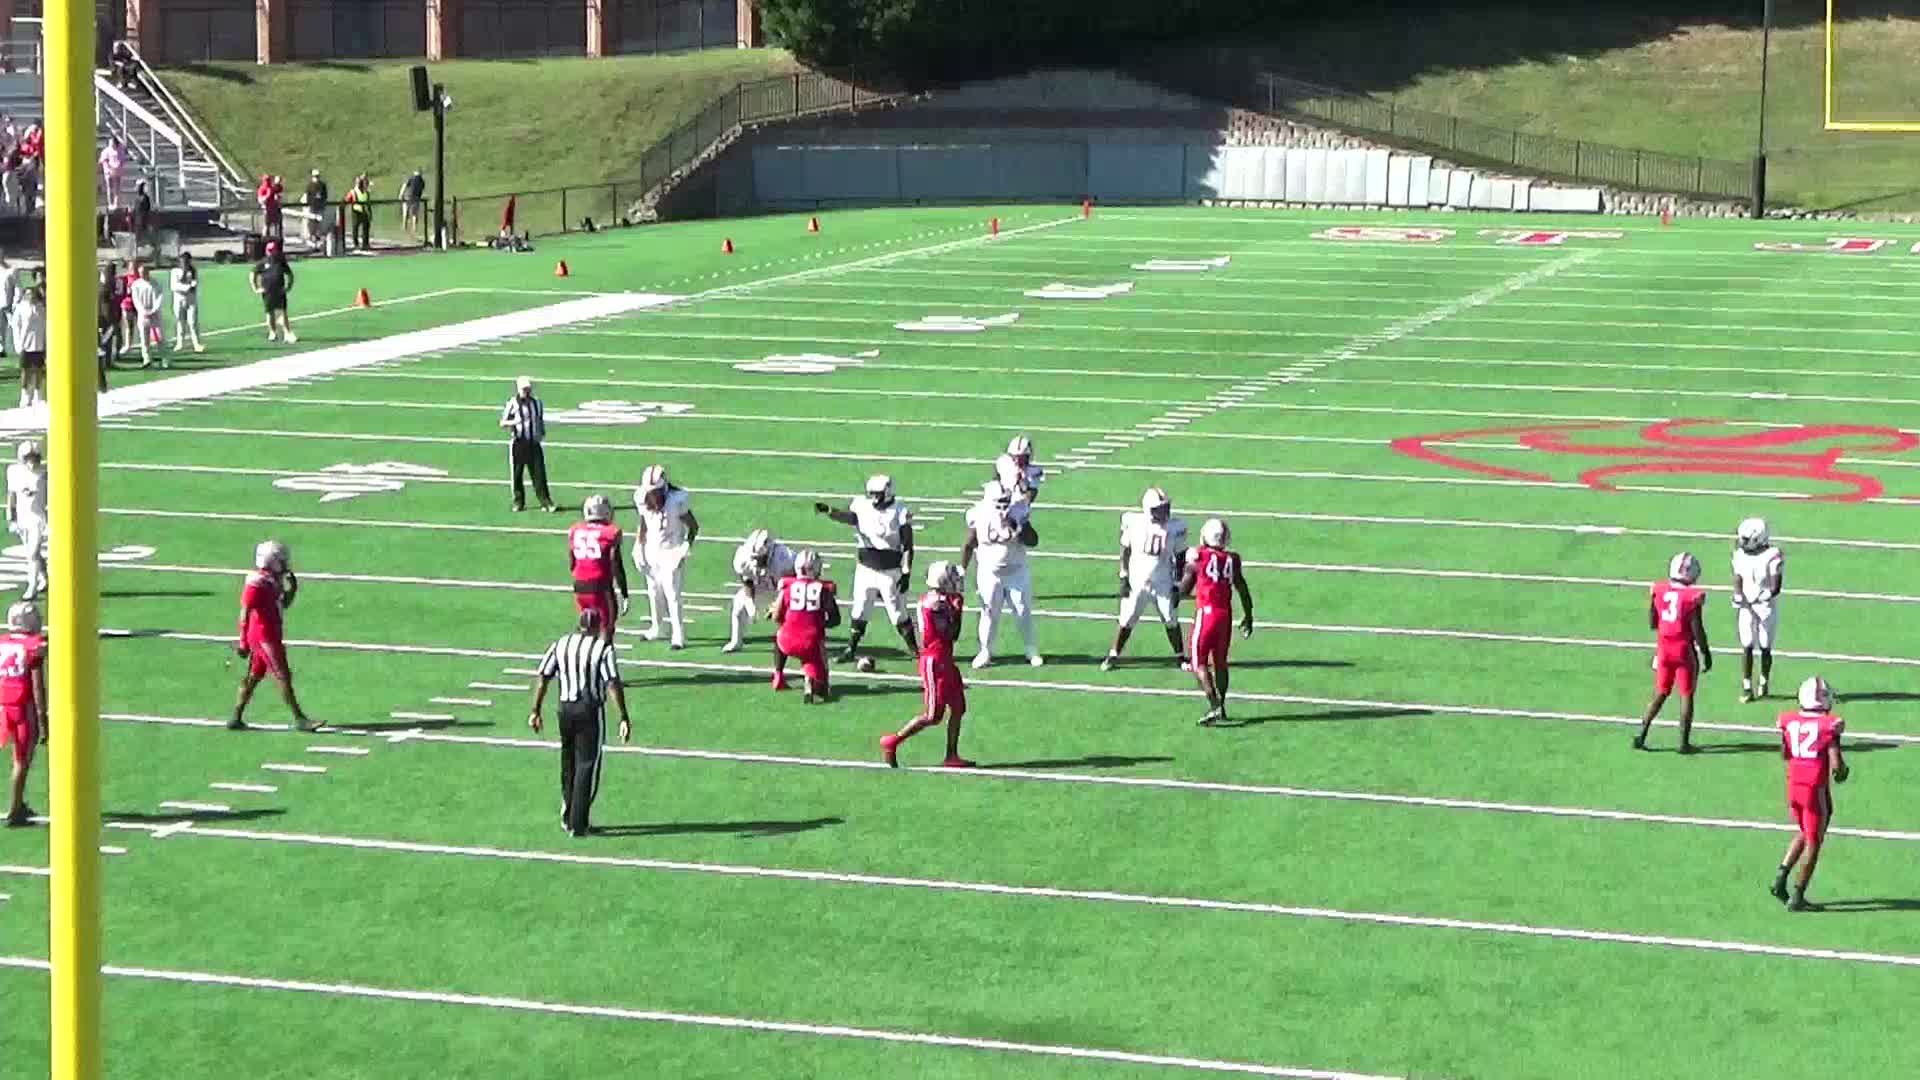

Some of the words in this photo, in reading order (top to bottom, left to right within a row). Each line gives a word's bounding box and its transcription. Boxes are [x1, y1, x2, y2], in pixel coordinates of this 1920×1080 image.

[573, 529, 601, 560] 55
[1206, 553, 1234, 583] 44
[789, 580, 823, 611] 99
[1660, 591, 1680, 622] 3
[1785, 720, 1820, 759] 12
